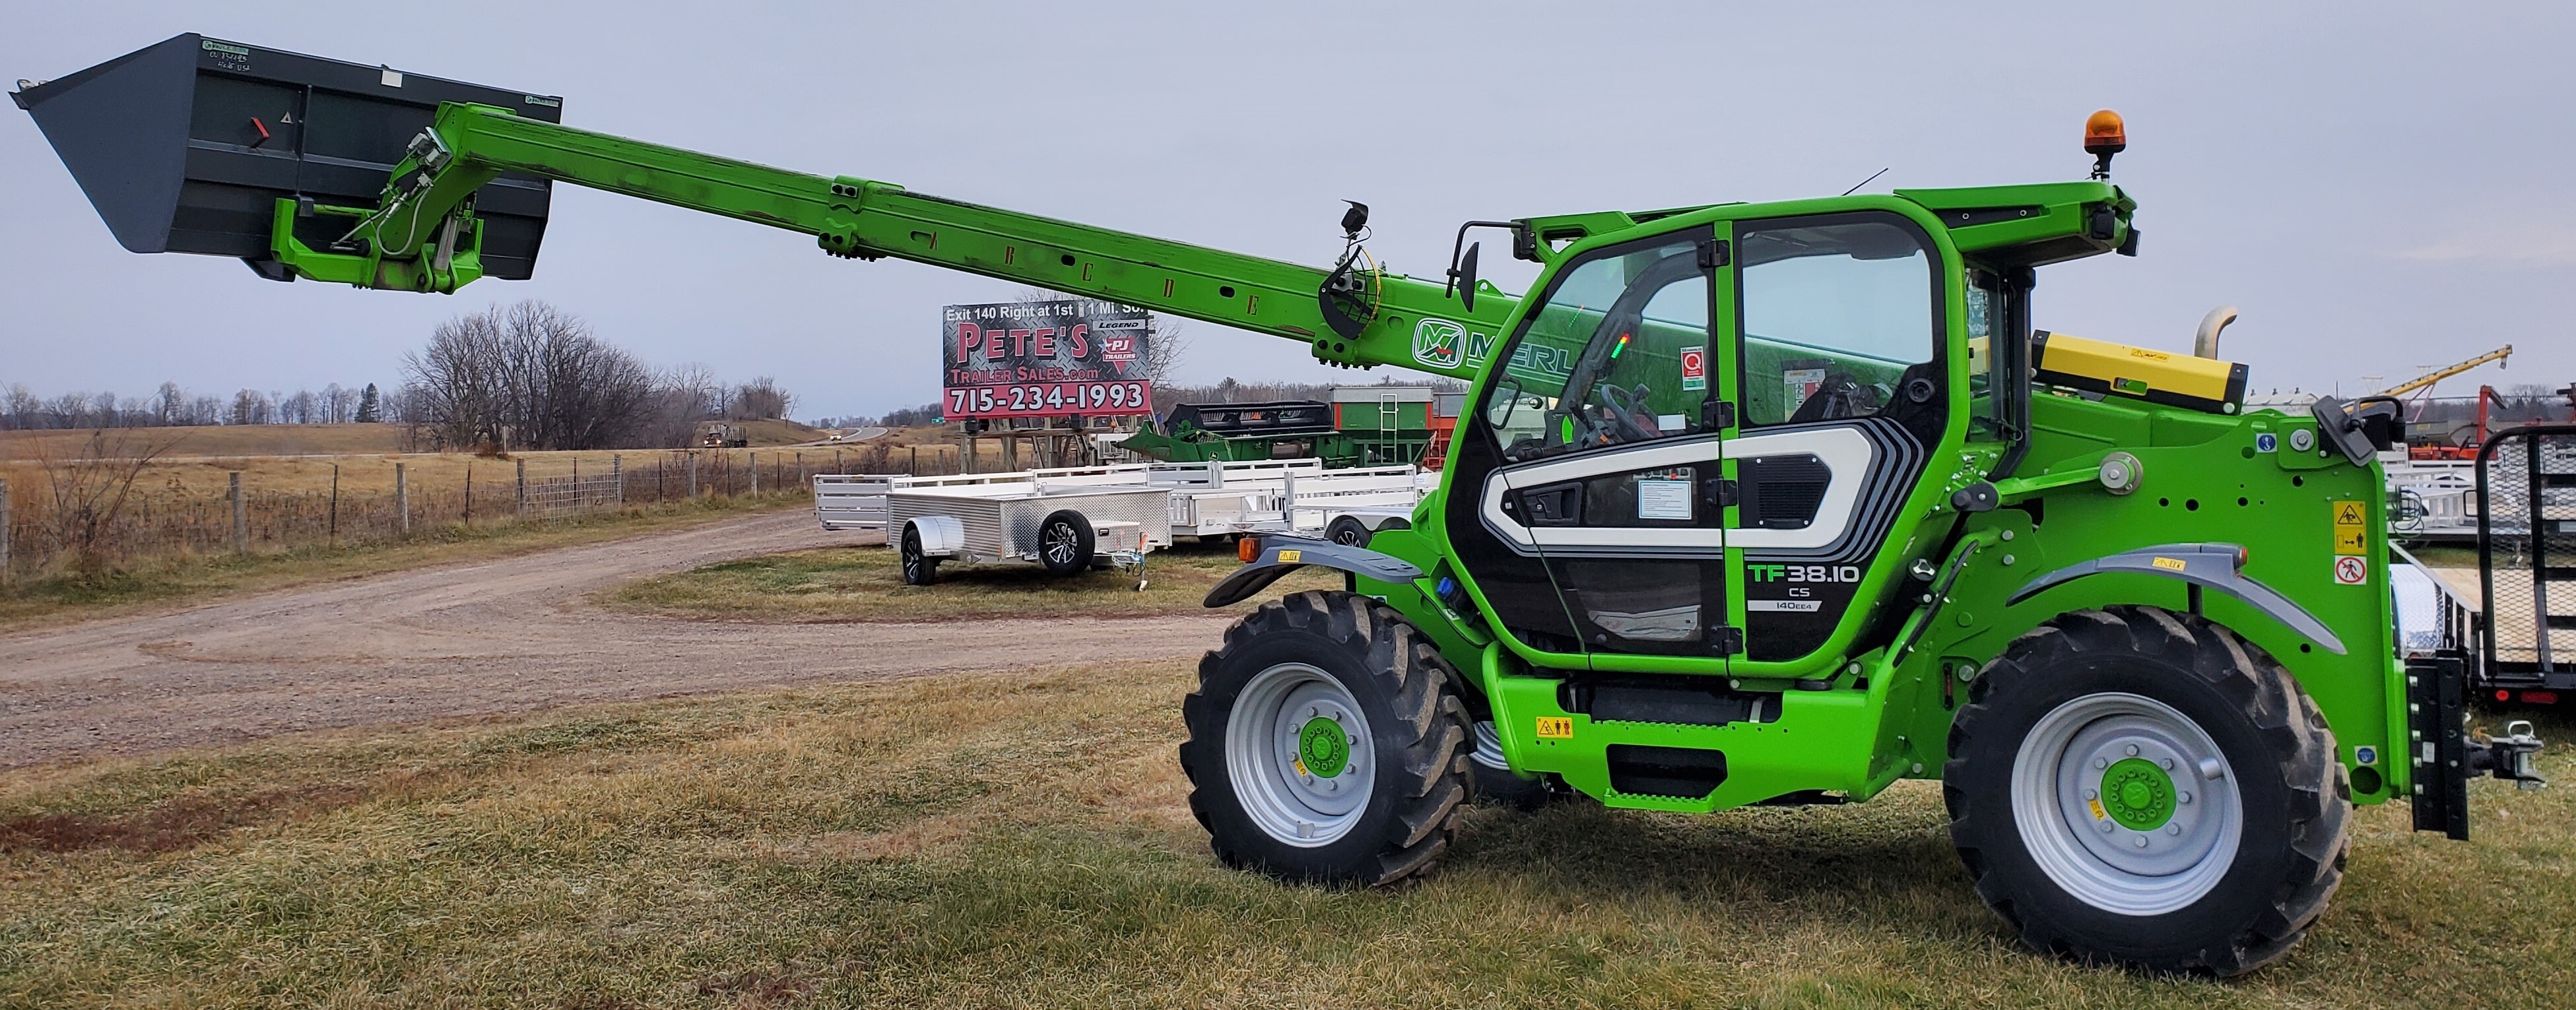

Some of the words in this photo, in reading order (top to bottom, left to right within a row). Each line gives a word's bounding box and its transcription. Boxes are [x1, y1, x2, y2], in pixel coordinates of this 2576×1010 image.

[1004, 245, 1015, 265] B
[1082, 262, 1094, 282] C
[1246, 294, 1259, 316] E
[946, 308, 971, 321] Exit
[975, 307, 997, 319] 140
[1000, 305, 1035, 321] Right
[1038, 304, 1051, 317] at
[1053, 303, 1074, 316] 1st
[1088, 302, 1095, 315] 1
[1100, 302, 1119, 314] Mi.
[958, 322, 1089, 363] PETE'S
[1111, 340, 1130, 351] PJ
[1467, 331, 1573, 376] MERL
[950, 367, 1012, 384] TRAILER
[950, 383, 1144, 414] 715-234-1993
[1789, 587, 1810, 597] CS
